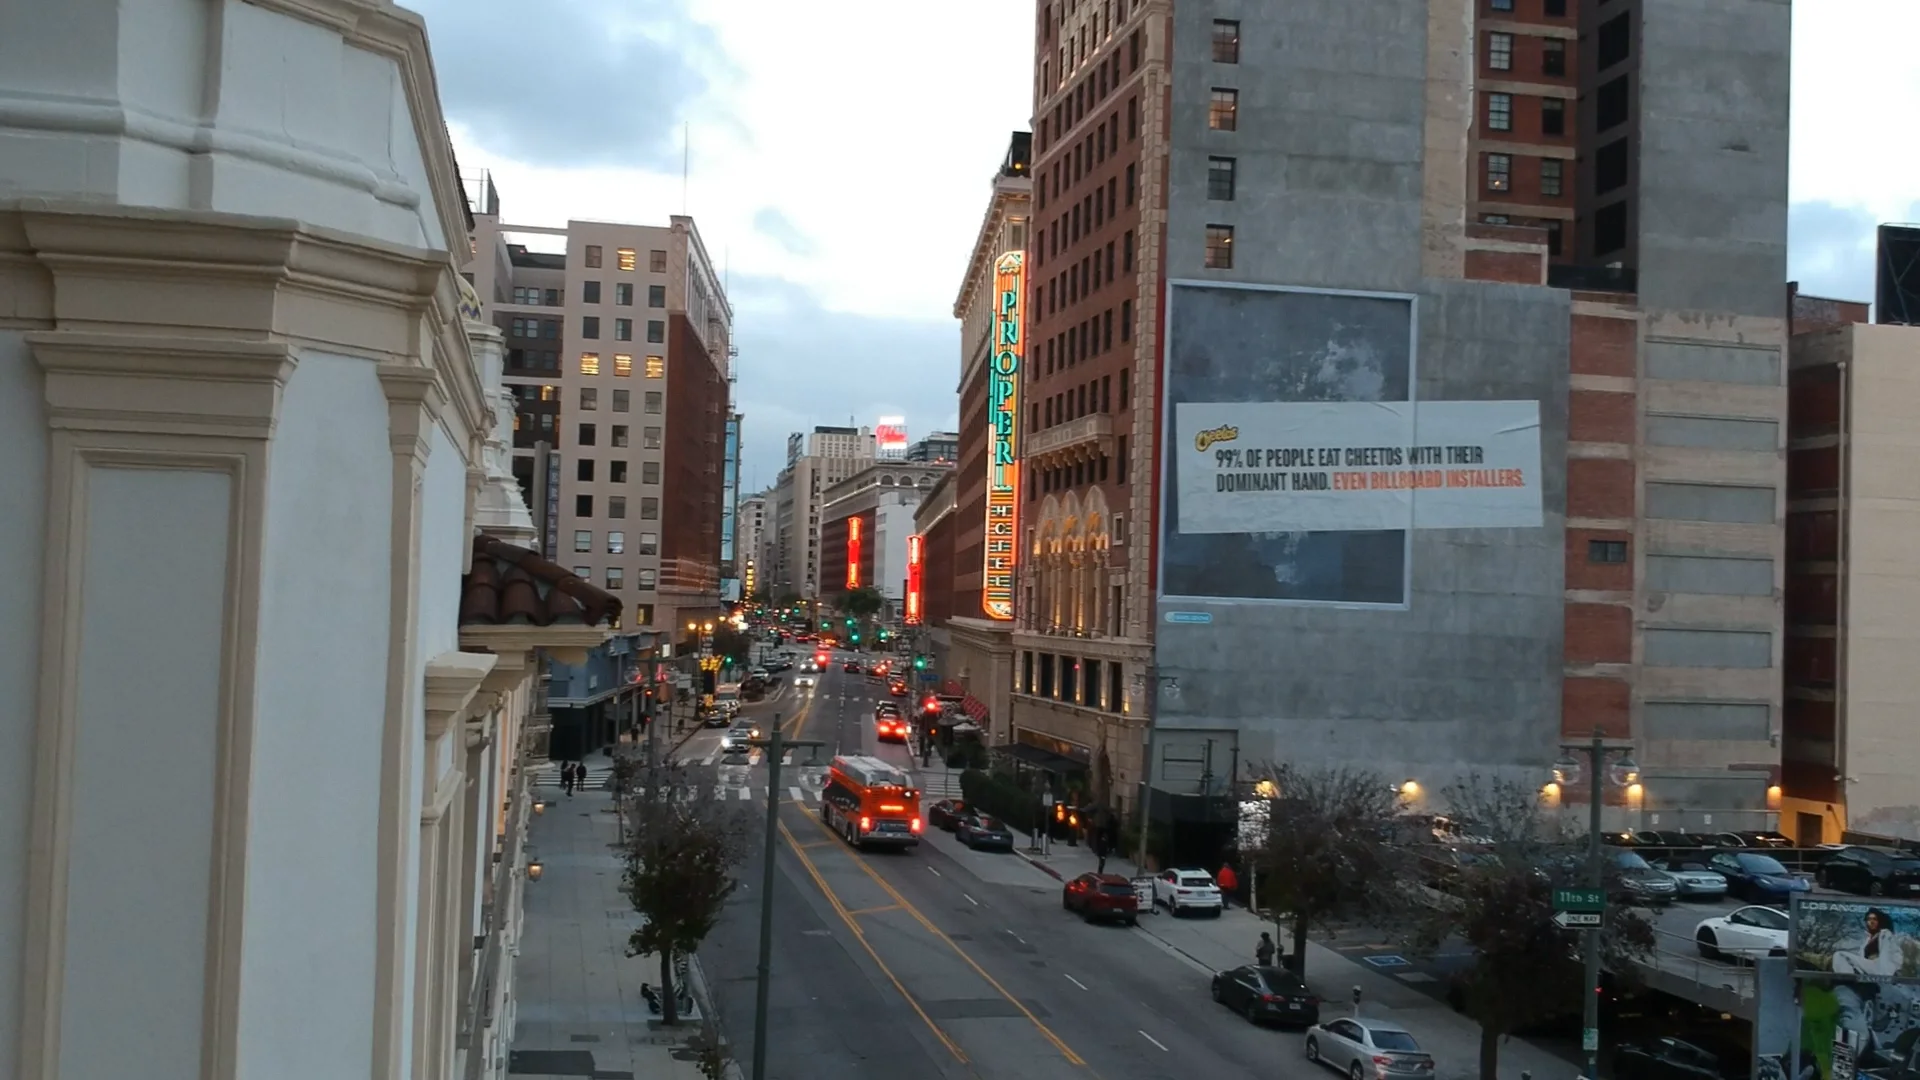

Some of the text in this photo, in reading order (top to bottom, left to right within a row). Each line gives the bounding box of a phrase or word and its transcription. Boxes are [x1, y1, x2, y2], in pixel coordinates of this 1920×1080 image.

[995, 291, 1018, 465] PROPER
[1195, 424, 1239, 452] Cheetos
[1216, 445, 1484, 468] 99% OF PEOPLE EAT CHEETOS WITH THEIR
[1216, 468, 1525, 492] DOMINANT HAND. EVEN BILLBOARD INSTALLERS.
[1560, 891, 1600, 903] 11th St
[1801, 902, 1828, 911] LOS
[1829, 902, 1890, 915] ANGELS
[1567, 914, 1581, 922] ONE
